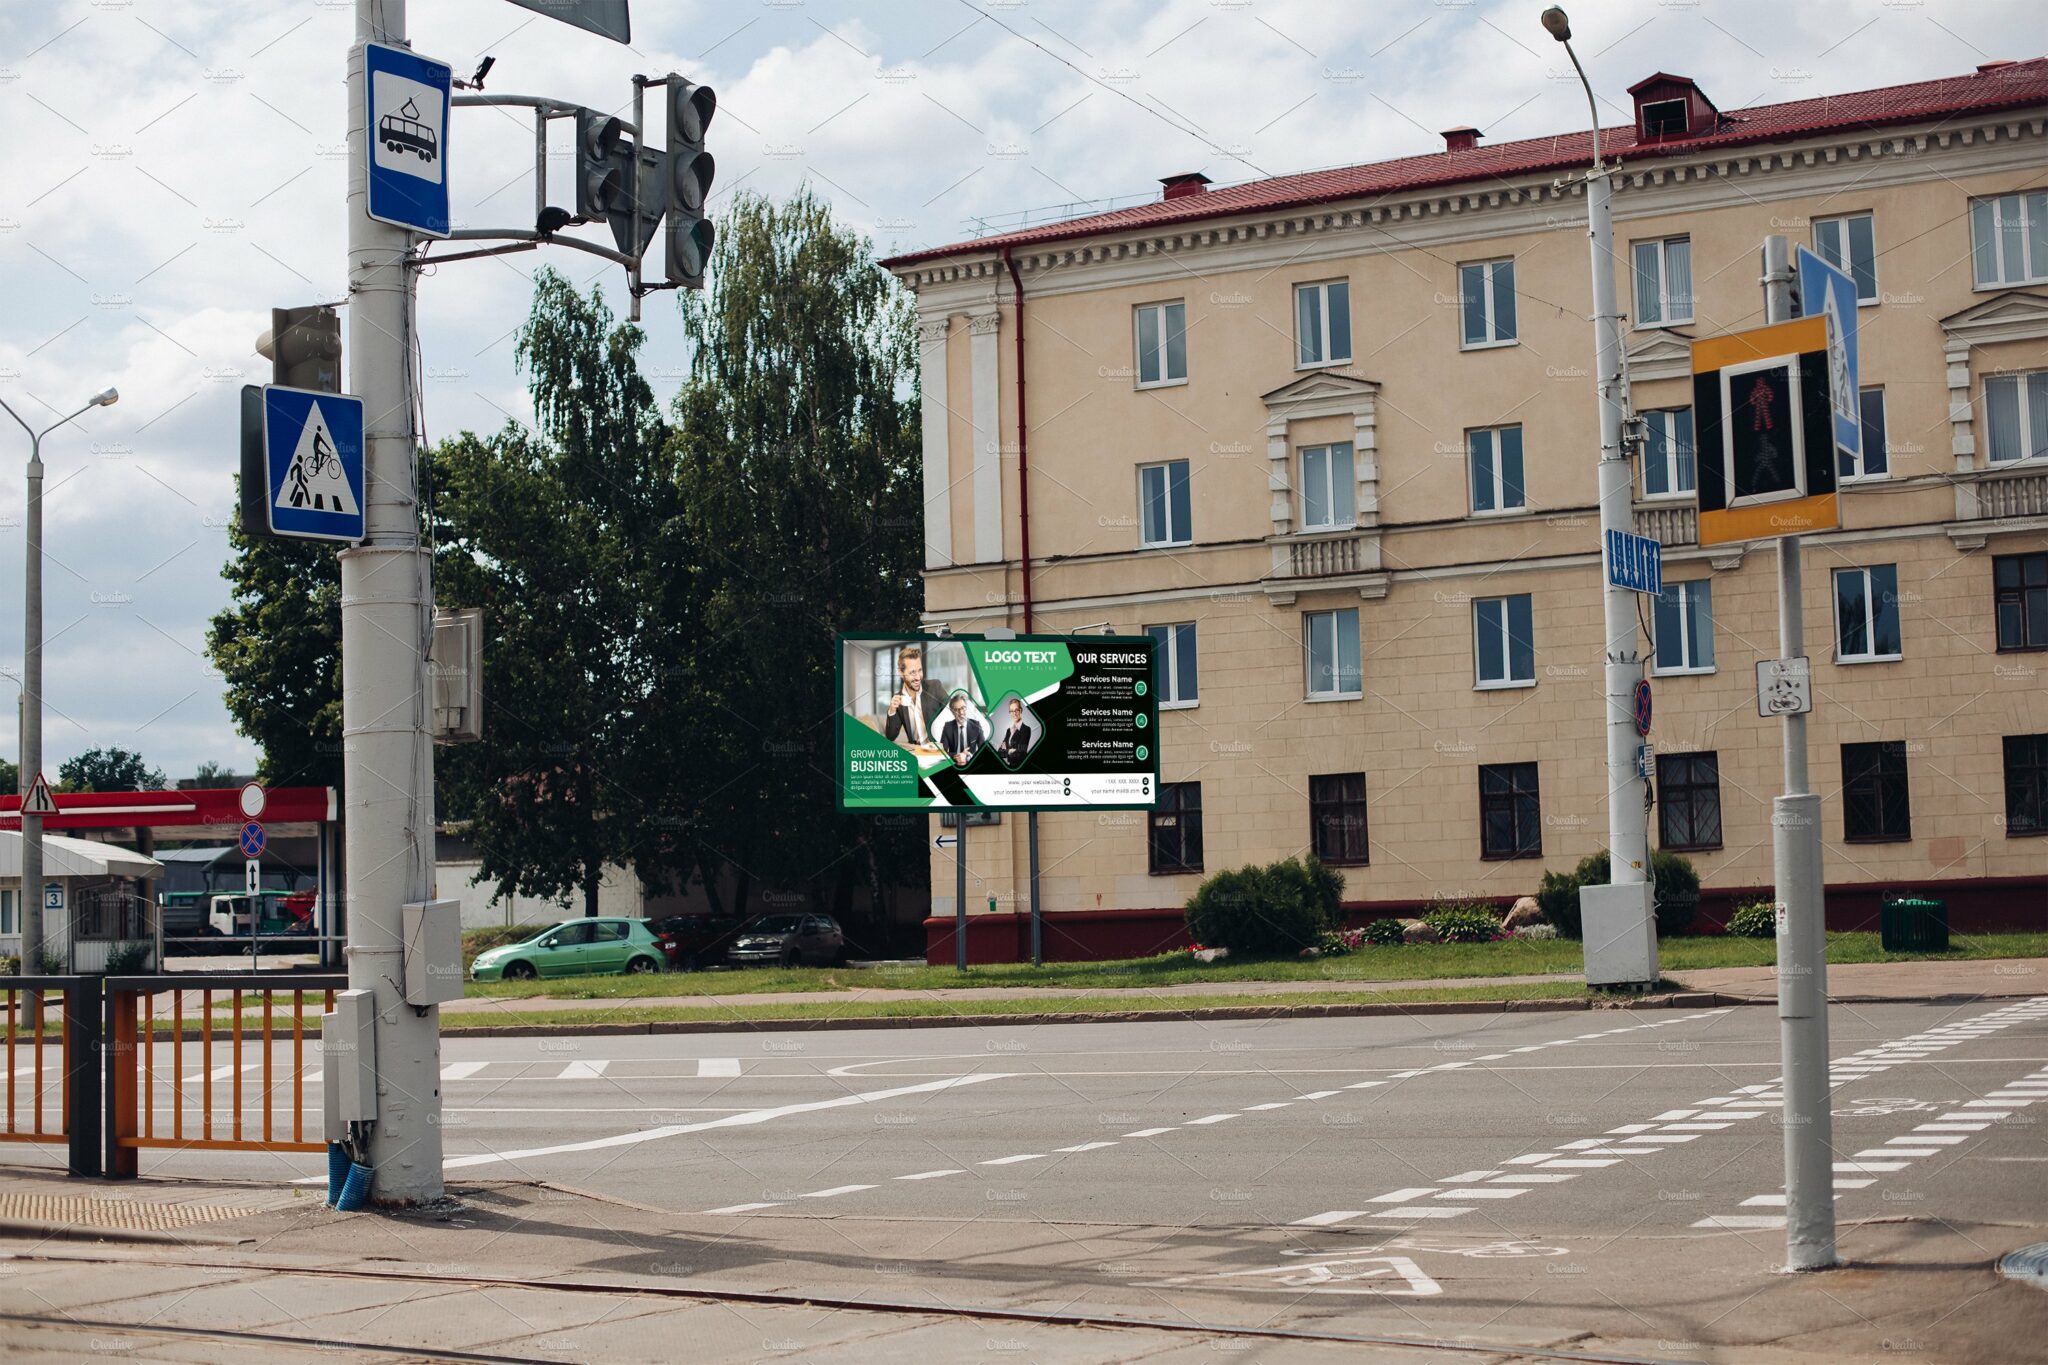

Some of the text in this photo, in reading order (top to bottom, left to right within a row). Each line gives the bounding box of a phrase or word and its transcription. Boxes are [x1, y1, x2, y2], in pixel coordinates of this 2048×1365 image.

[985, 651, 1057, 663] LOGO TEXT
[1076, 653, 1147, 664] OUR SERVICES
[1080, 675, 1133, 683] Services Name
[1081, 708, 1134, 716] Services Name
[1081, 740, 1112, 748] Services
[850, 749, 899, 759] GROW YOUR
[851, 760, 908, 772] BUSINESS
[50, 893, 58, 905] 3
